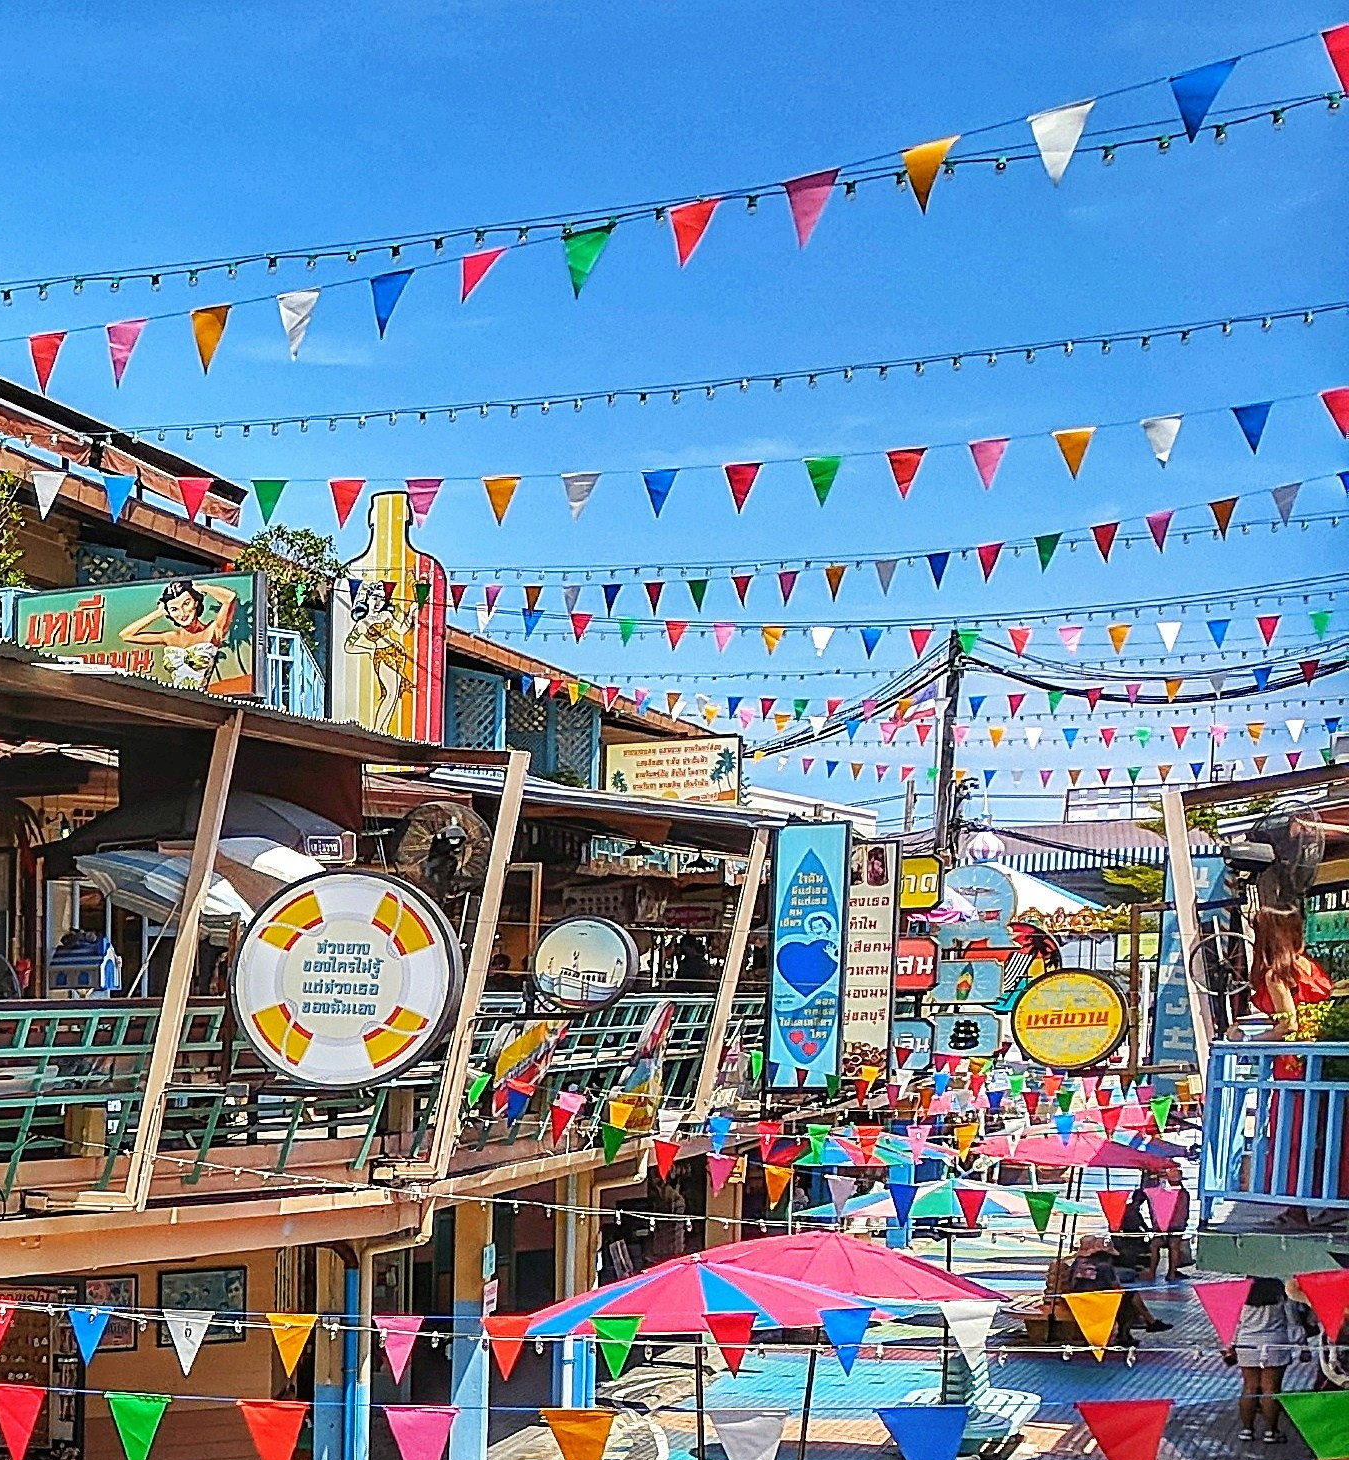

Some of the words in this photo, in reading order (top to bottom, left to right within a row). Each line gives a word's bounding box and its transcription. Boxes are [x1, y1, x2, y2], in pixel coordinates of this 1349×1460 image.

[27, 594, 105, 650] เทพี
[901, 874, 938, 893] าด
[849, 896, 890, 907] ลงเธอ
[317, 939, 371, 956] ห่วงยาง
[302, 956, 384, 980] ของใครไม่รู้
[897, 955, 934, 975] สน
[302, 979, 380, 996] แต่ห่วงเธอ
[845, 988, 889, 999] นองมน
[302, 998, 376, 1016] ของฉันเอง
[1026, 1008, 1110, 1026] เพลินวาน
